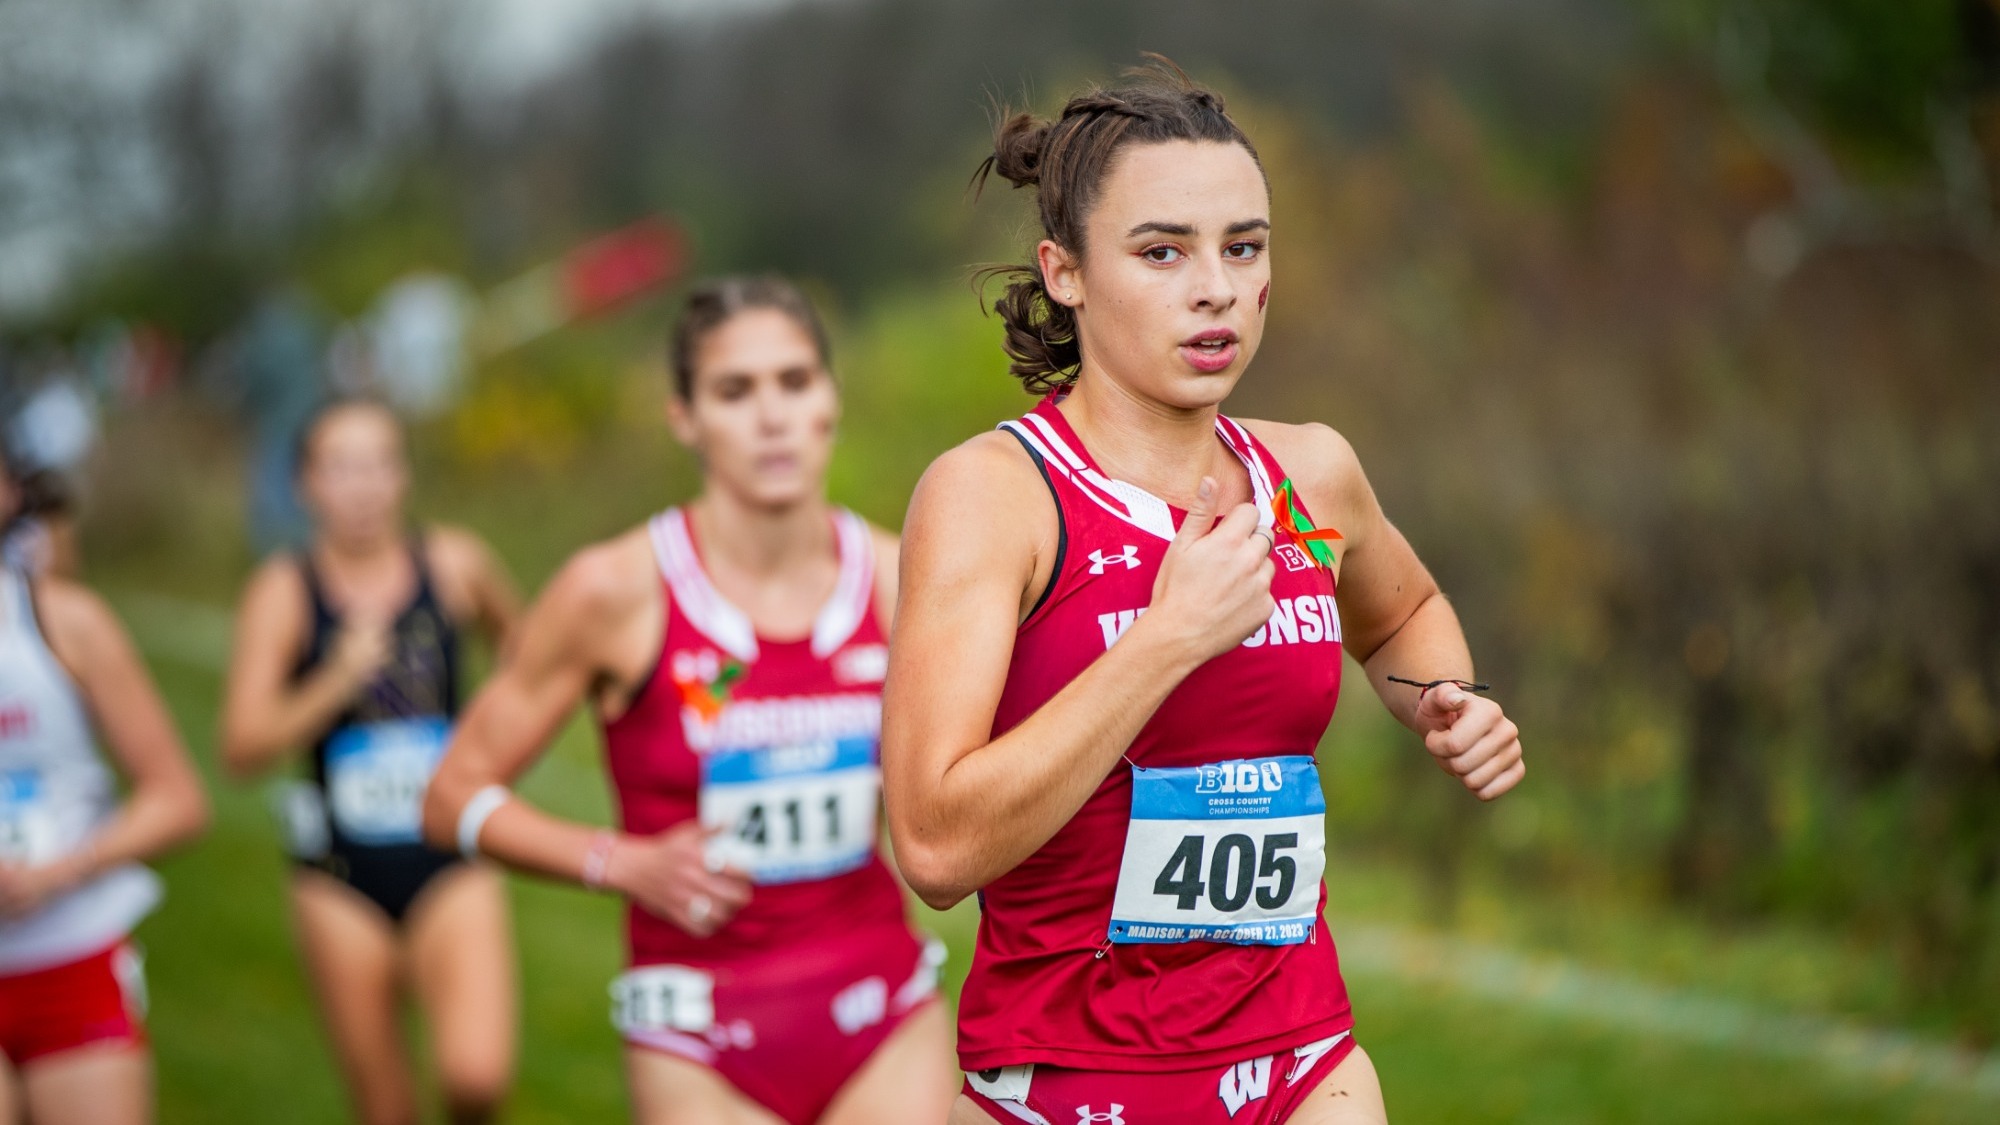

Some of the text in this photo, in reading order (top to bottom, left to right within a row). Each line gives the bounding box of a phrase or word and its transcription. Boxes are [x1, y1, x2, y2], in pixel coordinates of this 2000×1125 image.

[1208, 796, 1272, 806] CROSS COUNTRY
[1208, 806, 1270, 815] CHAMPIONSHIPS
[738, 795, 842, 847] 411
[1153, 832, 1298, 912] 405
[1188, 928, 1207, 939] WI
[1212, 926, 1263, 941] OCTOBER
[1264, 925, 1279, 940] 27,
[1279, 922, 1304, 939] 2023
[1218, 1055, 1274, 1120] W
